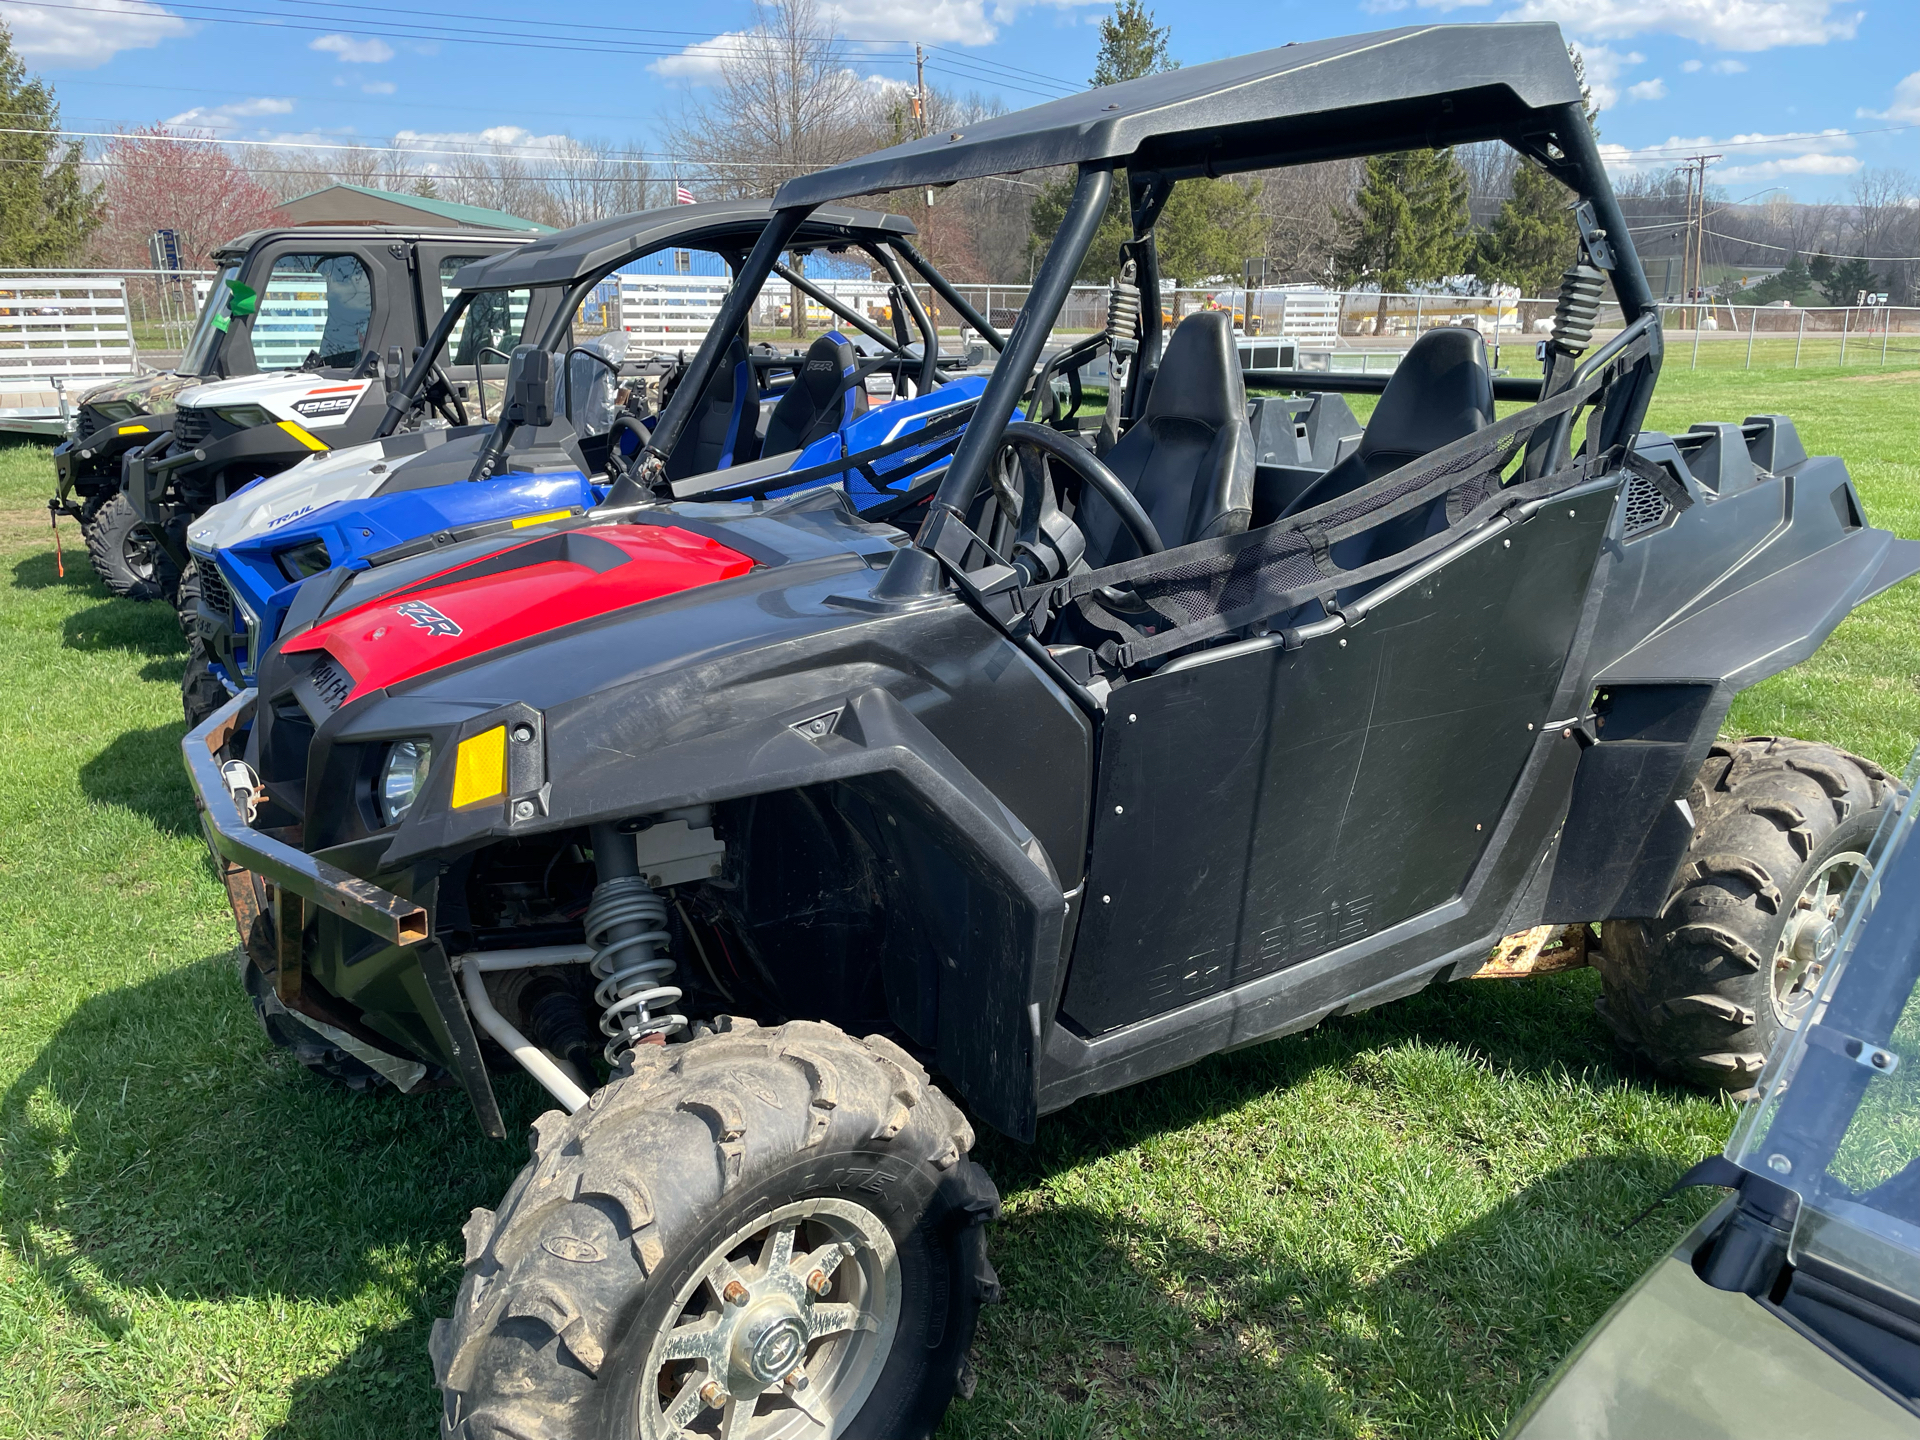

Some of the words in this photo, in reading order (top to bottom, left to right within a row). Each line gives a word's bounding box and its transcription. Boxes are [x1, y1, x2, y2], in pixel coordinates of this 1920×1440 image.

[806, 360, 834, 371] RZR
[297, 398, 353, 412] 1000
[267, 504, 314, 528] TRAIL
[388, 599, 464, 637] RZR
[794, 1166, 899, 1195] LITE
